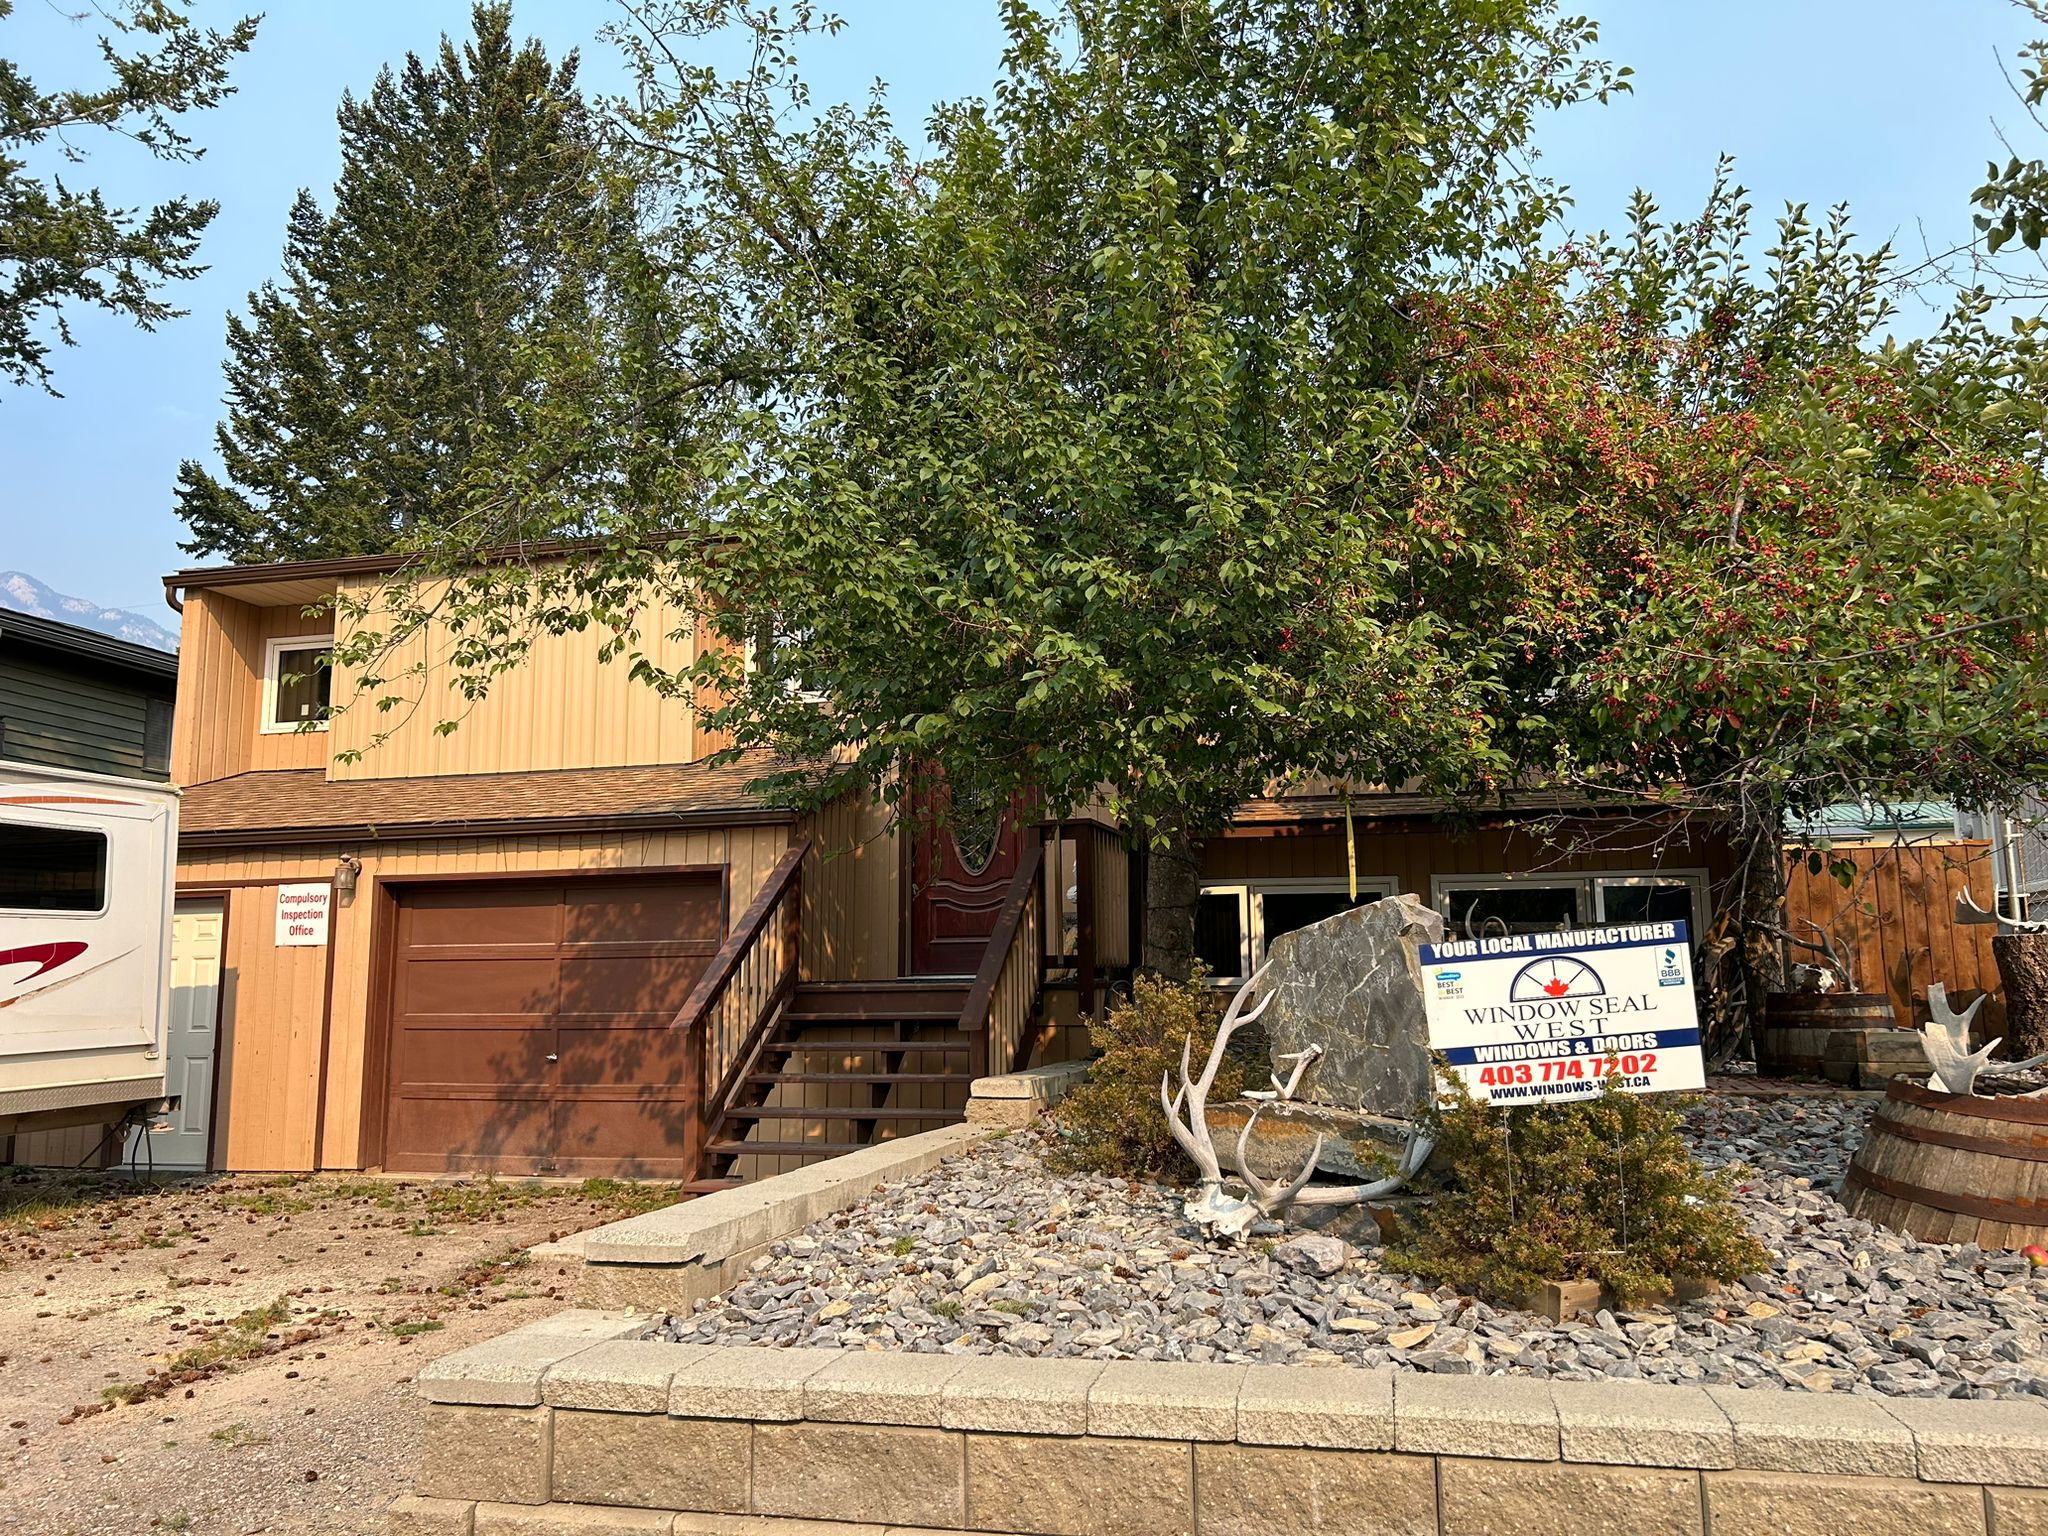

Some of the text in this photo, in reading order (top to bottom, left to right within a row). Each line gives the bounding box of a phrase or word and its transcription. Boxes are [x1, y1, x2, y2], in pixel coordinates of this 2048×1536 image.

[279, 892, 328, 906] Compulsory
[281, 908, 323, 922] Inspection
[288, 924, 314, 936] Office
[1431, 923, 1676, 959] YOUR LOCAL MANUFACTURER
[1661, 968, 1681, 977] BBB
[1437, 981, 1454, 989] BEST
[1446, 987, 1463, 995] BEST
[1464, 994, 1658, 1025] WINDOW SEAL
[1513, 1018, 1609, 1041] WEST
[1474, 1033, 1658, 1063] WINDOWS & DOORS
[1479, 1053, 1657, 1087] 403 774 7202
[1490, 1076, 1651, 1100] WWW.WINDOWS-WST.CA
